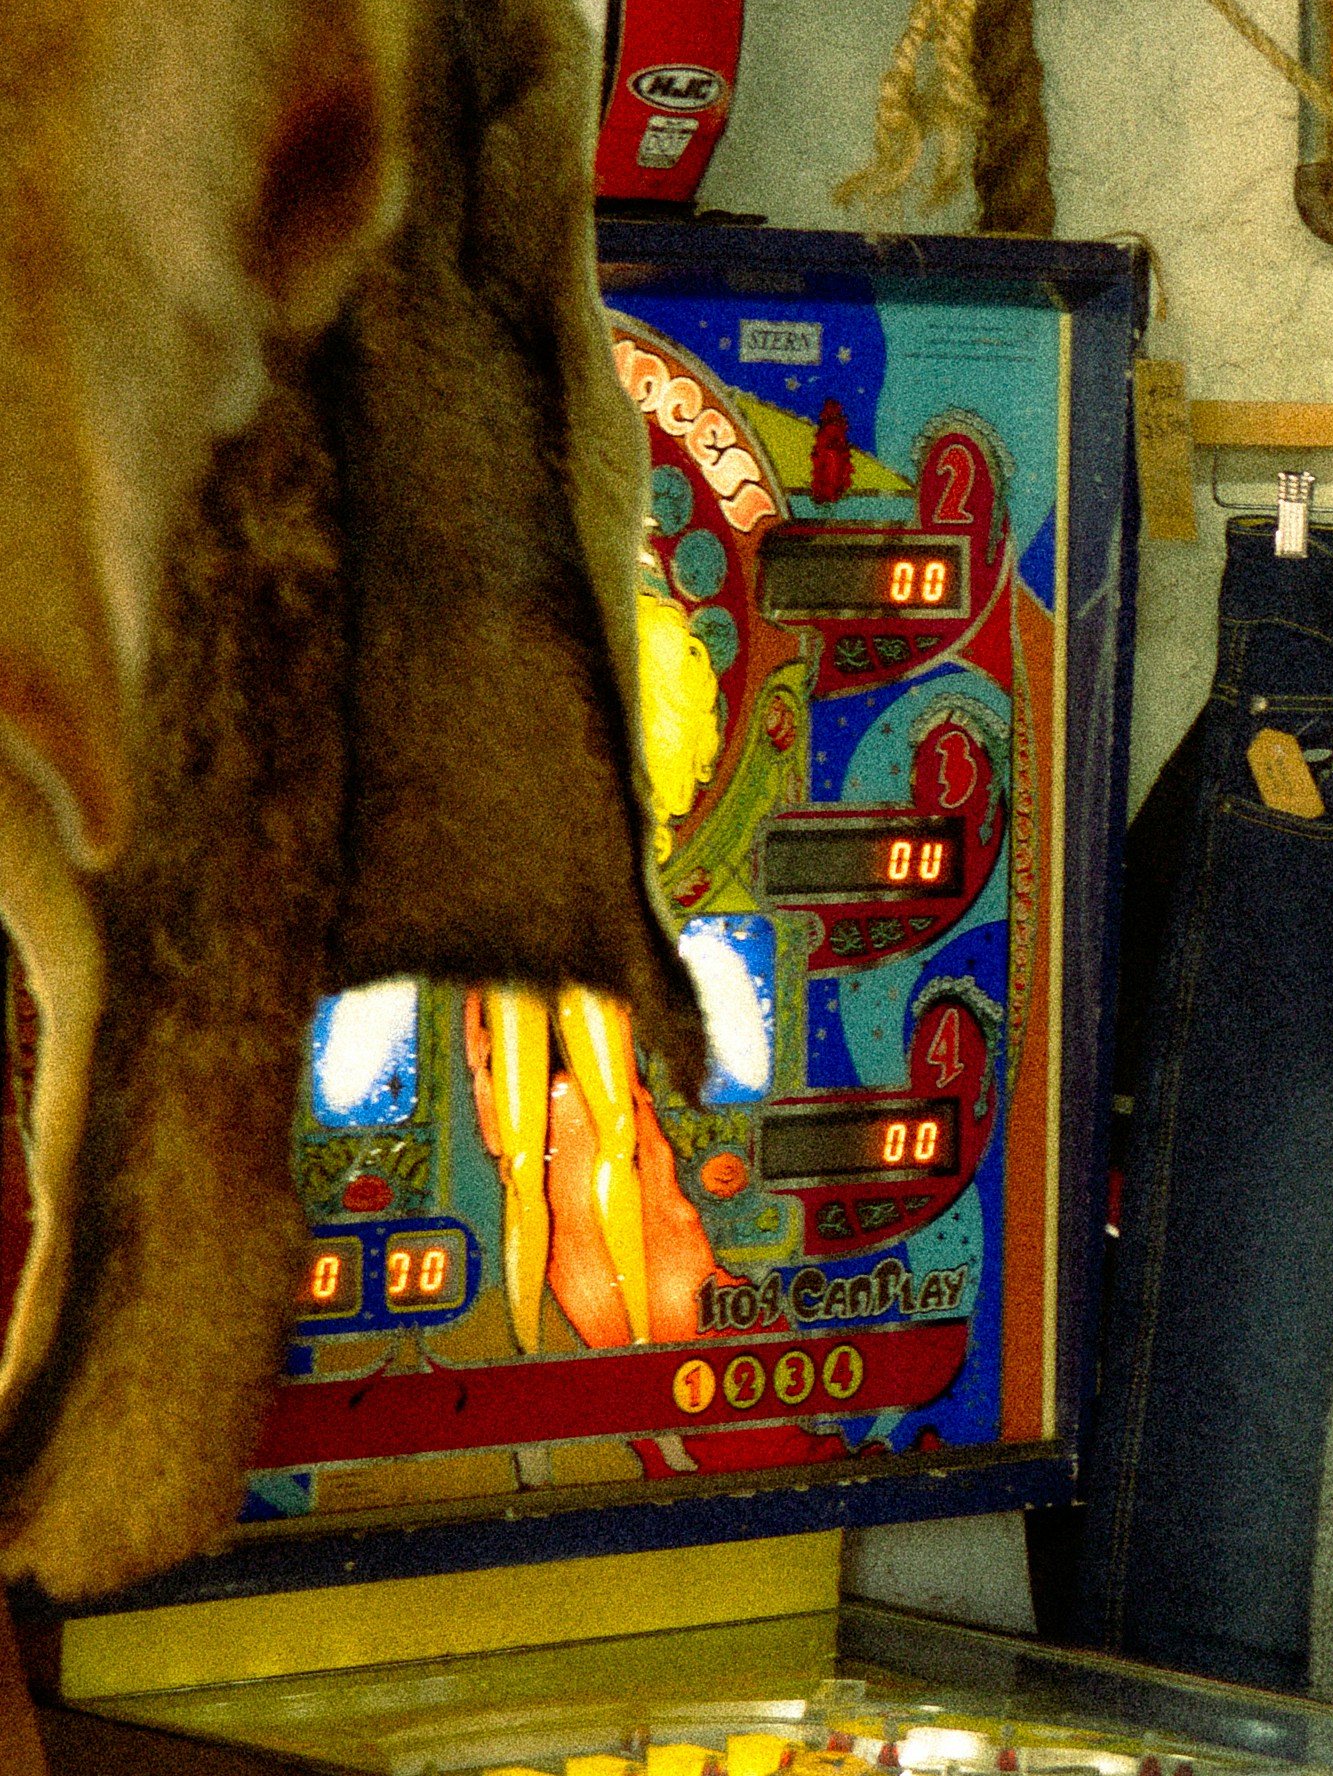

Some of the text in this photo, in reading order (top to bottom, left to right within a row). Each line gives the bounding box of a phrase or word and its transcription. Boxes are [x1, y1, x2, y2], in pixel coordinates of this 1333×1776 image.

[747, 329, 815, 352] STERN
[933, 443, 974, 524] 2
[889, 561, 947, 603] 00
[926, 1008, 965, 1088] 4
[882, 1121, 938, 1162] 00
